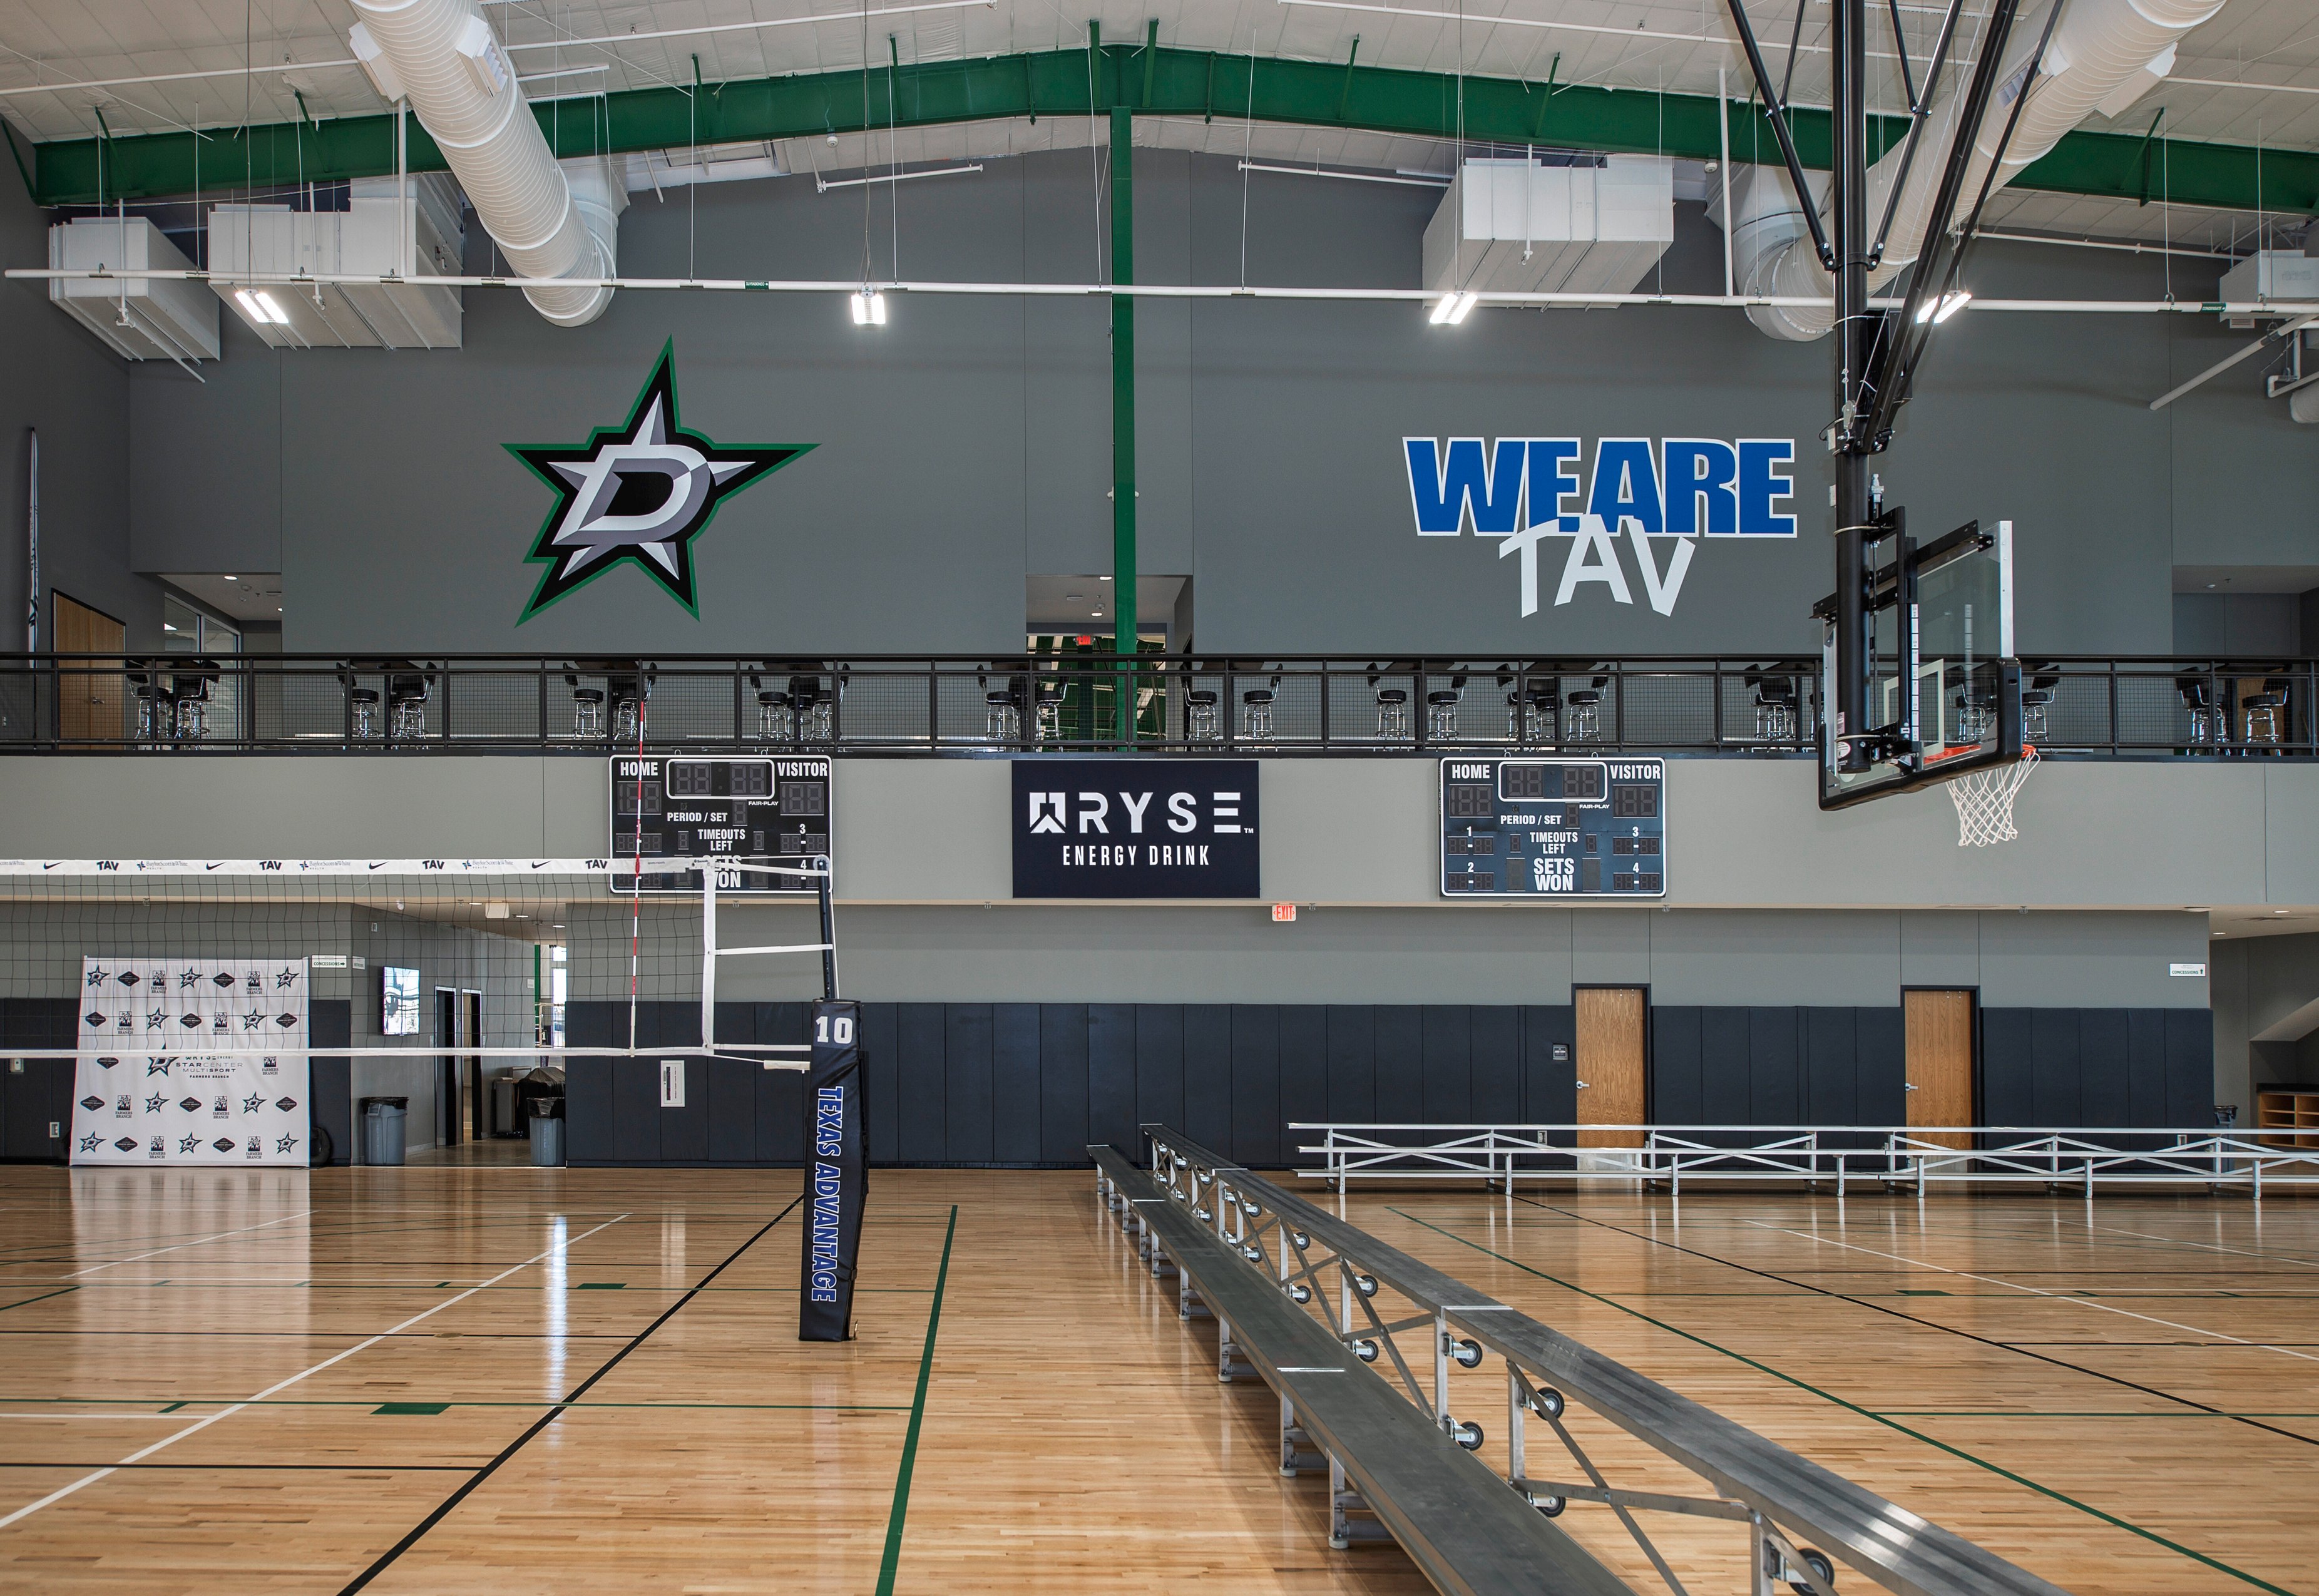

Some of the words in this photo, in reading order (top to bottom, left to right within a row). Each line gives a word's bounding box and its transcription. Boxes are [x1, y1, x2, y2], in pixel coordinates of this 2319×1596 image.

[1499, 514, 1696, 618] TAV
[620, 762, 658, 776] HOME
[777, 762, 827, 777] VISITOR
[1452, 765, 1490, 779] HOME
[1610, 765, 1661, 779] VISITOR
[667, 812, 702, 822] PERIOD
[710, 812, 728, 822] SET
[1500, 816, 1535, 824] PERIOD
[1544, 816, 1562, 824] SET
[799, 824, 806, 834] 3
[1467, 827, 1472, 837] 1
[1632, 827, 1639, 837] 3
[698, 829, 745, 840] TIMEOUTS
[1530, 832, 1578, 842] TIMEOUTS
[710, 841, 732, 851] LEFT
[1543, 844, 1565, 854] LEFT
[1063, 846, 1137, 866] ENERGY
[1150, 846, 1209, 866] DRINK
[96, 861, 119, 871] TAV
[259, 861, 282, 871] TAV
[422, 861, 444, 870] TAV
[585, 859, 608, 869] TAV
[800, 859, 807, 870] 4
[1467, 862, 1474, 872] 2
[1533, 858, 1574, 874] SETS
[1632, 862, 1639, 872] 4
[1534, 875, 1573, 891] WON
[1276, 905, 1293, 920] EXIT
[816, 1016, 853, 1043] 10
[816, 1086, 843, 1156] TEXAS
[811, 1162, 840, 1302] ADVANTAGE
